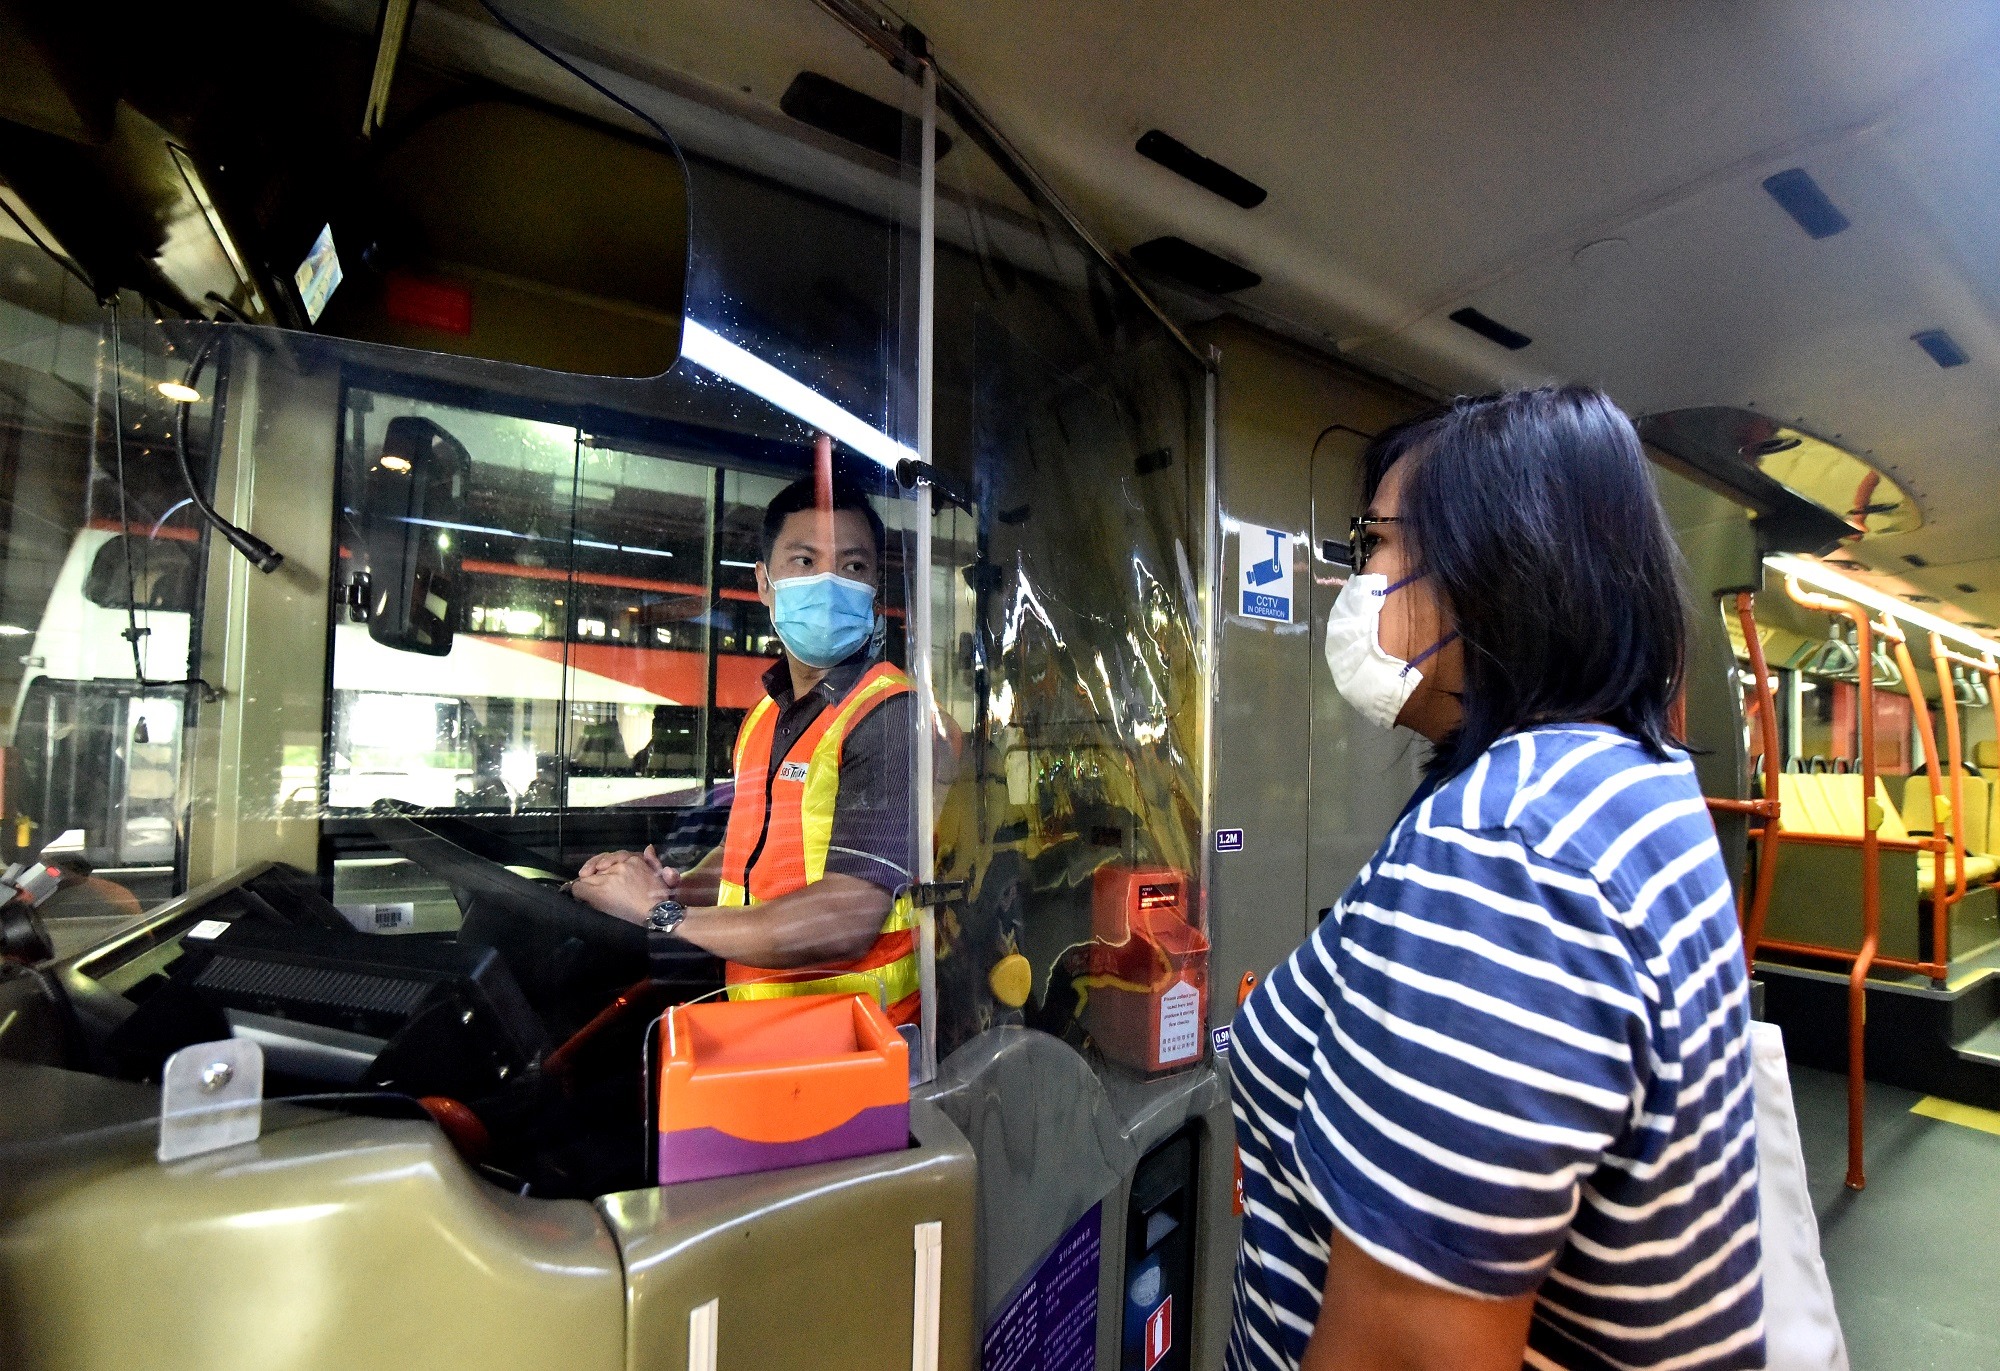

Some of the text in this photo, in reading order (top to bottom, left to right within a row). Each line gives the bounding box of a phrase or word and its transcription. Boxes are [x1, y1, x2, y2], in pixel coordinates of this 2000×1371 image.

[1256, 596, 1278, 608] CCTV
[1254, 606, 1284, 618] OPERATION
[1219, 834, 1237, 844] 1.2M
